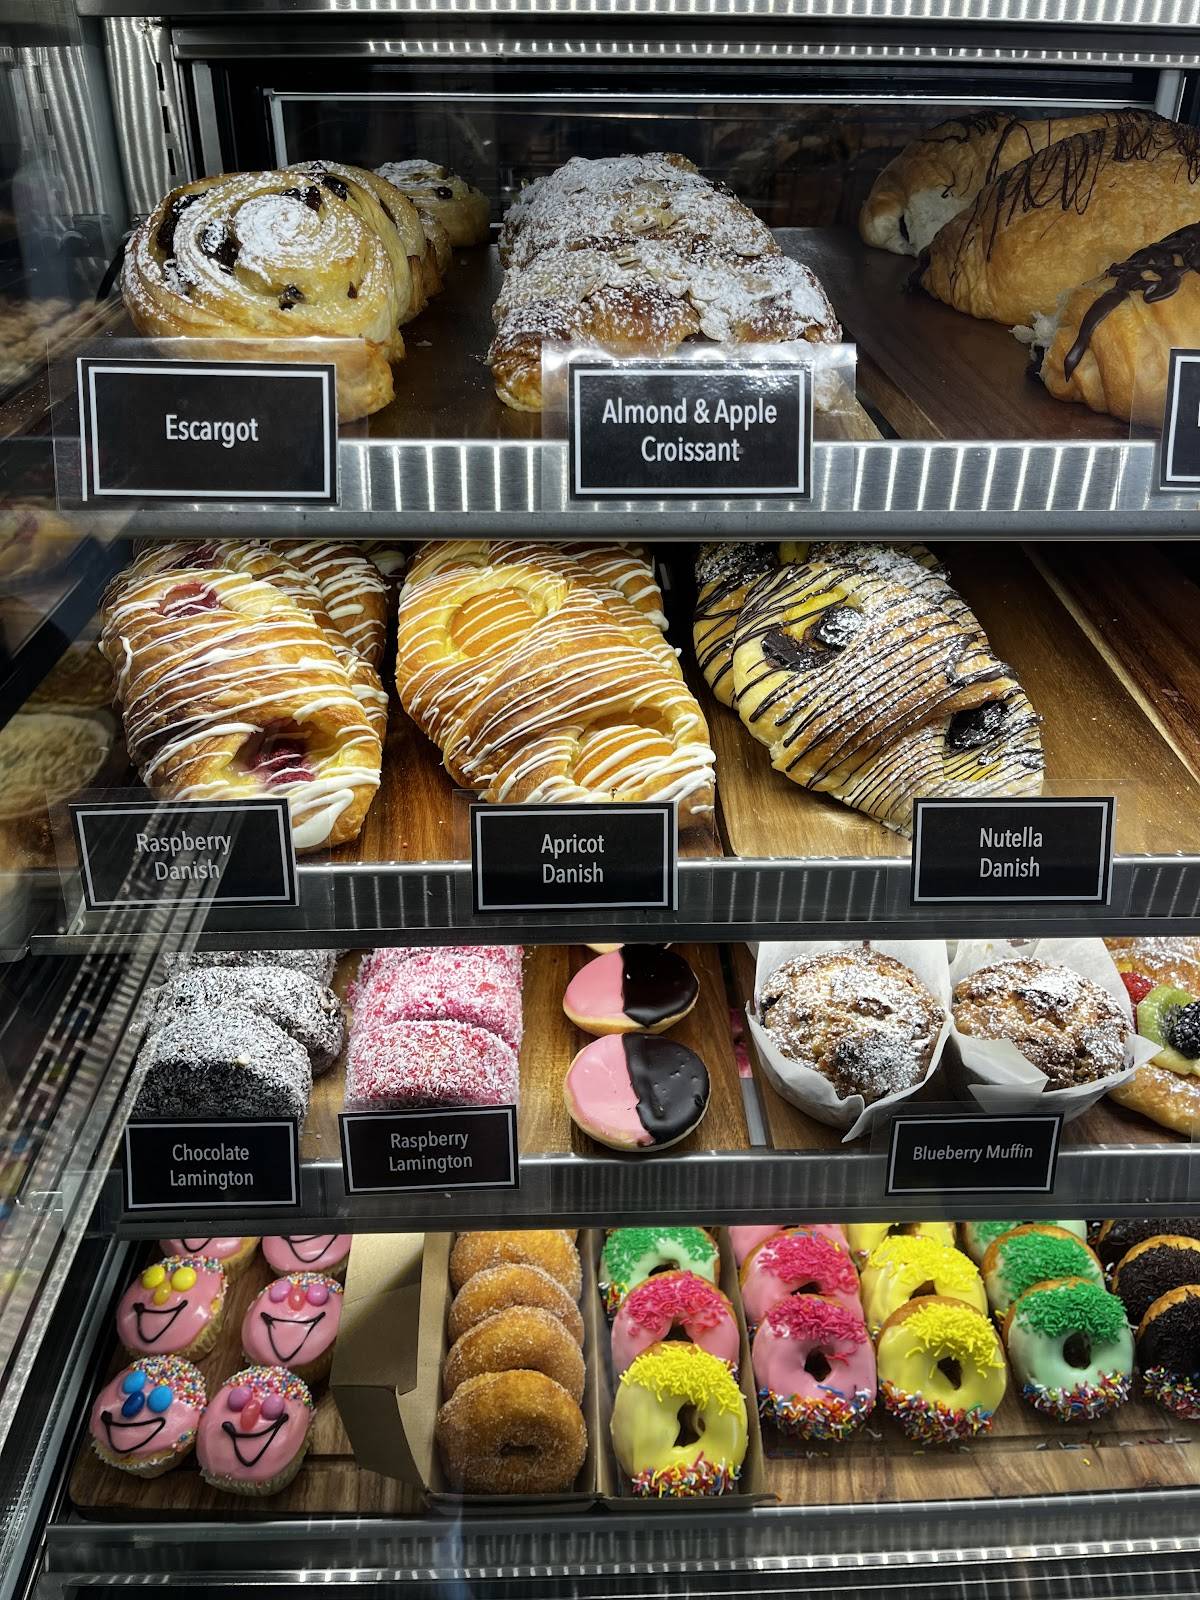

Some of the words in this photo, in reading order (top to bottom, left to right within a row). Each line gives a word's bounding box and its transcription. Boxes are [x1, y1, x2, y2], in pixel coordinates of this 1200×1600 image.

[601, 397, 688, 424] Almond
[693, 398, 711, 424] &
[713, 397, 777, 431] Apple
[165, 414, 259, 448] Escargot
[641, 435, 741, 462] Croissant
[135, 831, 232, 857] Raspberry
[540, 833, 605, 860] Apricot
[979, 826, 1043, 848] Nutella
[154, 858, 221, 881] Danish
[542, 861, 604, 884] Danish
[979, 856, 1040, 878] Danish
[172, 1142, 250, 1162] Chocolate
[390, 1130, 469, 1153] Raspberry
[913, 1144, 983, 1163] Blueberry
[986, 1143, 1034, 1159] Muffin
[389, 1154, 473, 1174] Lamington
[170, 1169, 254, 1191] Lamington
